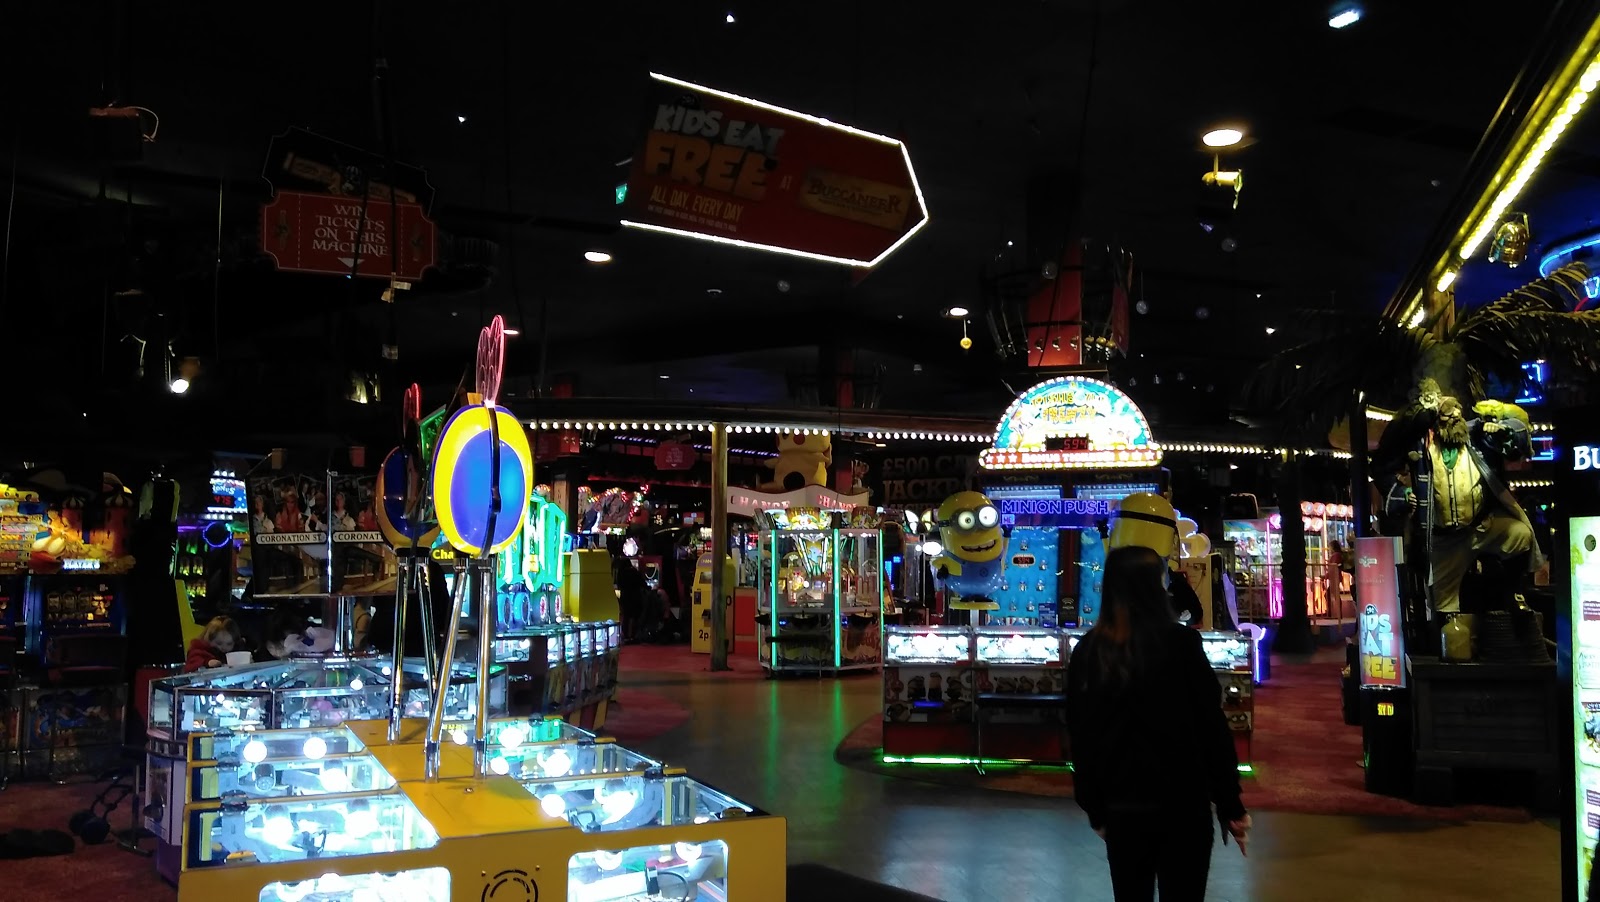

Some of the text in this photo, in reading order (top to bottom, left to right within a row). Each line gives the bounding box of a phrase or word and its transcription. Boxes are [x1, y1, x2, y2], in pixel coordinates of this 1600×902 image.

[653, 103, 785, 155] KIDS EAT
[644, 130, 773, 203] FREE
[778, 176, 793, 191] AT
[650, 184, 667, 203] ALL
[692, 195, 723, 218] EVERY
[722, 201, 744, 222] DAY
[808, 181, 903, 214] BUCCANEER
[334, 204, 368, 219] WIN
[315, 227, 386, 243] ON THIS
[312, 239, 388, 257] MACHINE
[1063, 439, 1089, 449] 594
[1002, 500, 1110, 515] MINION PUSH
[260, 534, 310, 543] CORONATION
[338, 533, 382, 541] CORONAT
[698, 629, 709, 641] 2p
[1363, 655, 1397, 680] REE
